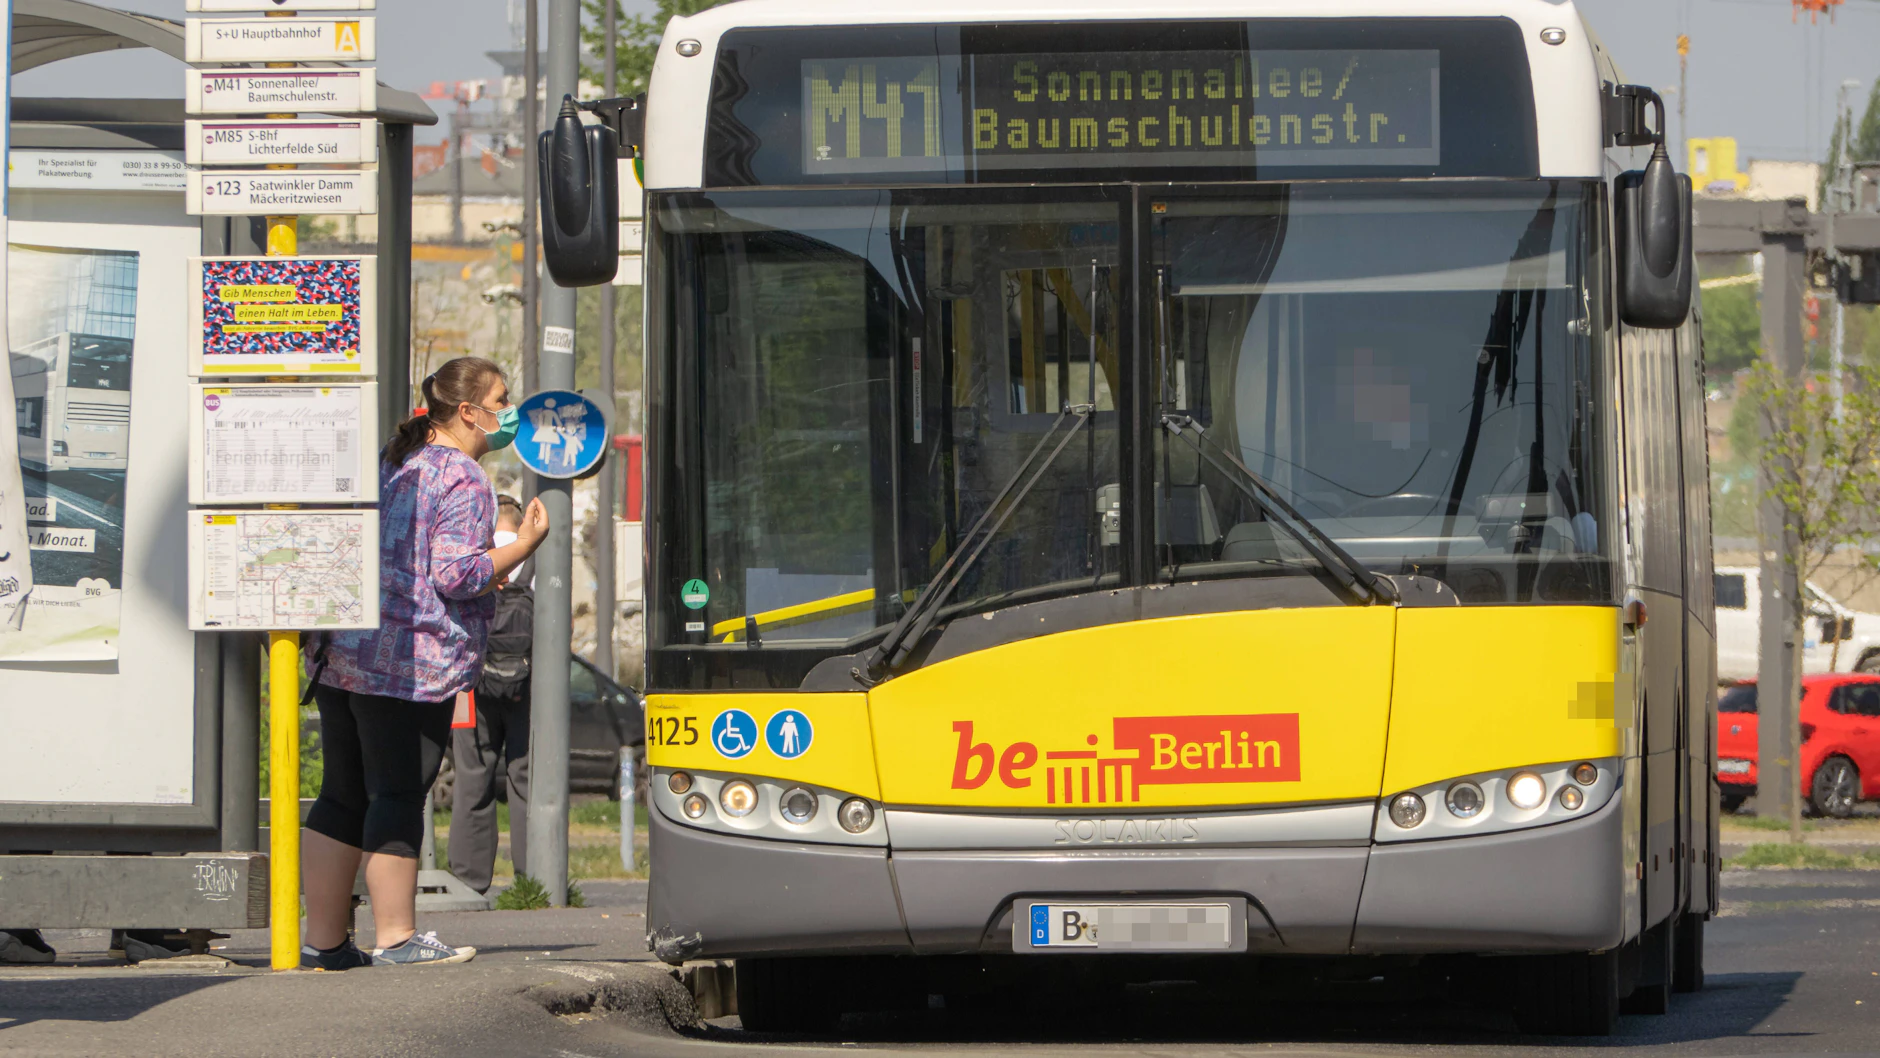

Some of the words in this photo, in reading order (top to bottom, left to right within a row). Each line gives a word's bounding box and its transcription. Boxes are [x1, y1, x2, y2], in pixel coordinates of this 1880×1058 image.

[216, 29, 239, 39] S+U
[242, 27, 322, 40] Hauptbahnhof
[337, 25, 359, 52] A
[214, 78, 240, 91] M41
[248, 77, 319, 89] Sonnenallee/
[1013, 56, 1359, 102] Sonnenallee/
[248, 91, 338, 103] Baumschulenstr.
[811, 63, 940, 159] M41
[973, 102, 1406, 149] Baumschulenstr.
[215, 130, 243, 143] M85
[248, 130, 278, 141] S-Bhf
[248, 143, 315, 155] Lichterfelde
[317, 142, 338, 154] Süd
[51, 159, 85, 169] Spezialist
[87, 160, 97, 168] für
[123, 161, 142, 170] (030)
[38, 170, 94, 178] Plakatwerbung.
[216, 180, 241, 196] 123
[249, 180, 315, 191] Saatwinkler
[318, 180, 353, 190] Damm
[250, 193, 342, 204] Mäckeritzwiesen
[224, 288, 240, 298] Gib
[242, 288, 292, 298] Menschen
[239, 309, 265, 318] einen
[268, 308, 289, 318] Halt
[291, 309, 304, 318] im
[307, 307, 338, 318] Leben.
[205, 399, 220, 407] BUS
[216, 448, 330, 468] Ferienfahrplan
[37, 532, 88, 548] Monat.
[85, 588, 101, 596] BVG
[691, 580, 700, 594] 4
[648, 716, 699, 746] 4125
[951, 720, 1038, 790] be
[1150, 730, 1281, 771] Berlin
[1036, 929, 1044, 939] D
[1062, 910, 1082, 941] B
